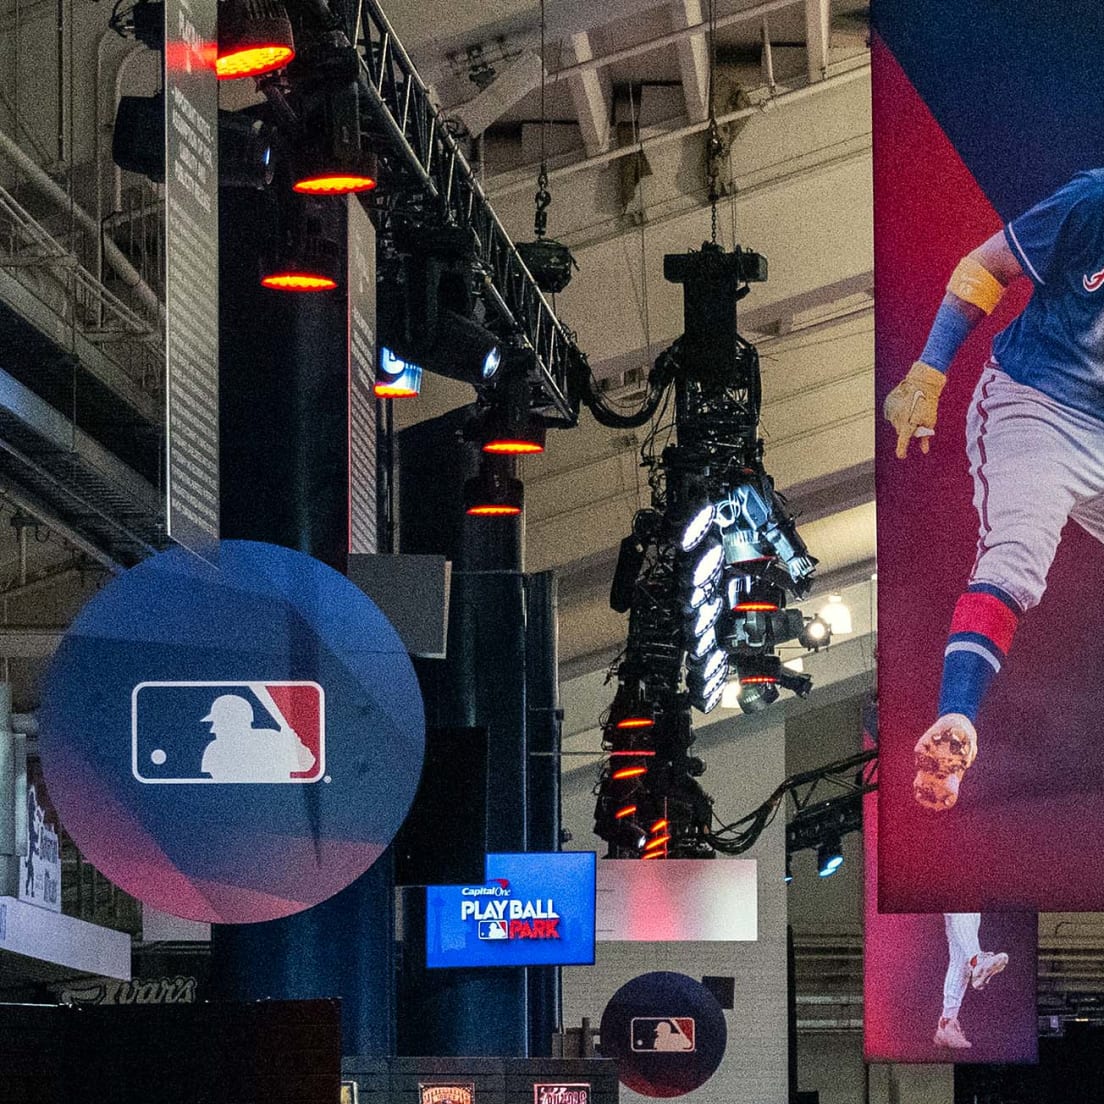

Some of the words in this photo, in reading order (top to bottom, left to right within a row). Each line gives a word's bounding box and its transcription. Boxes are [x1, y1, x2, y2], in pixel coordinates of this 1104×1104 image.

[461, 900, 508, 920] PLAY
[510, 899, 560, 919] BALL
[510, 919, 559, 939] PARK
